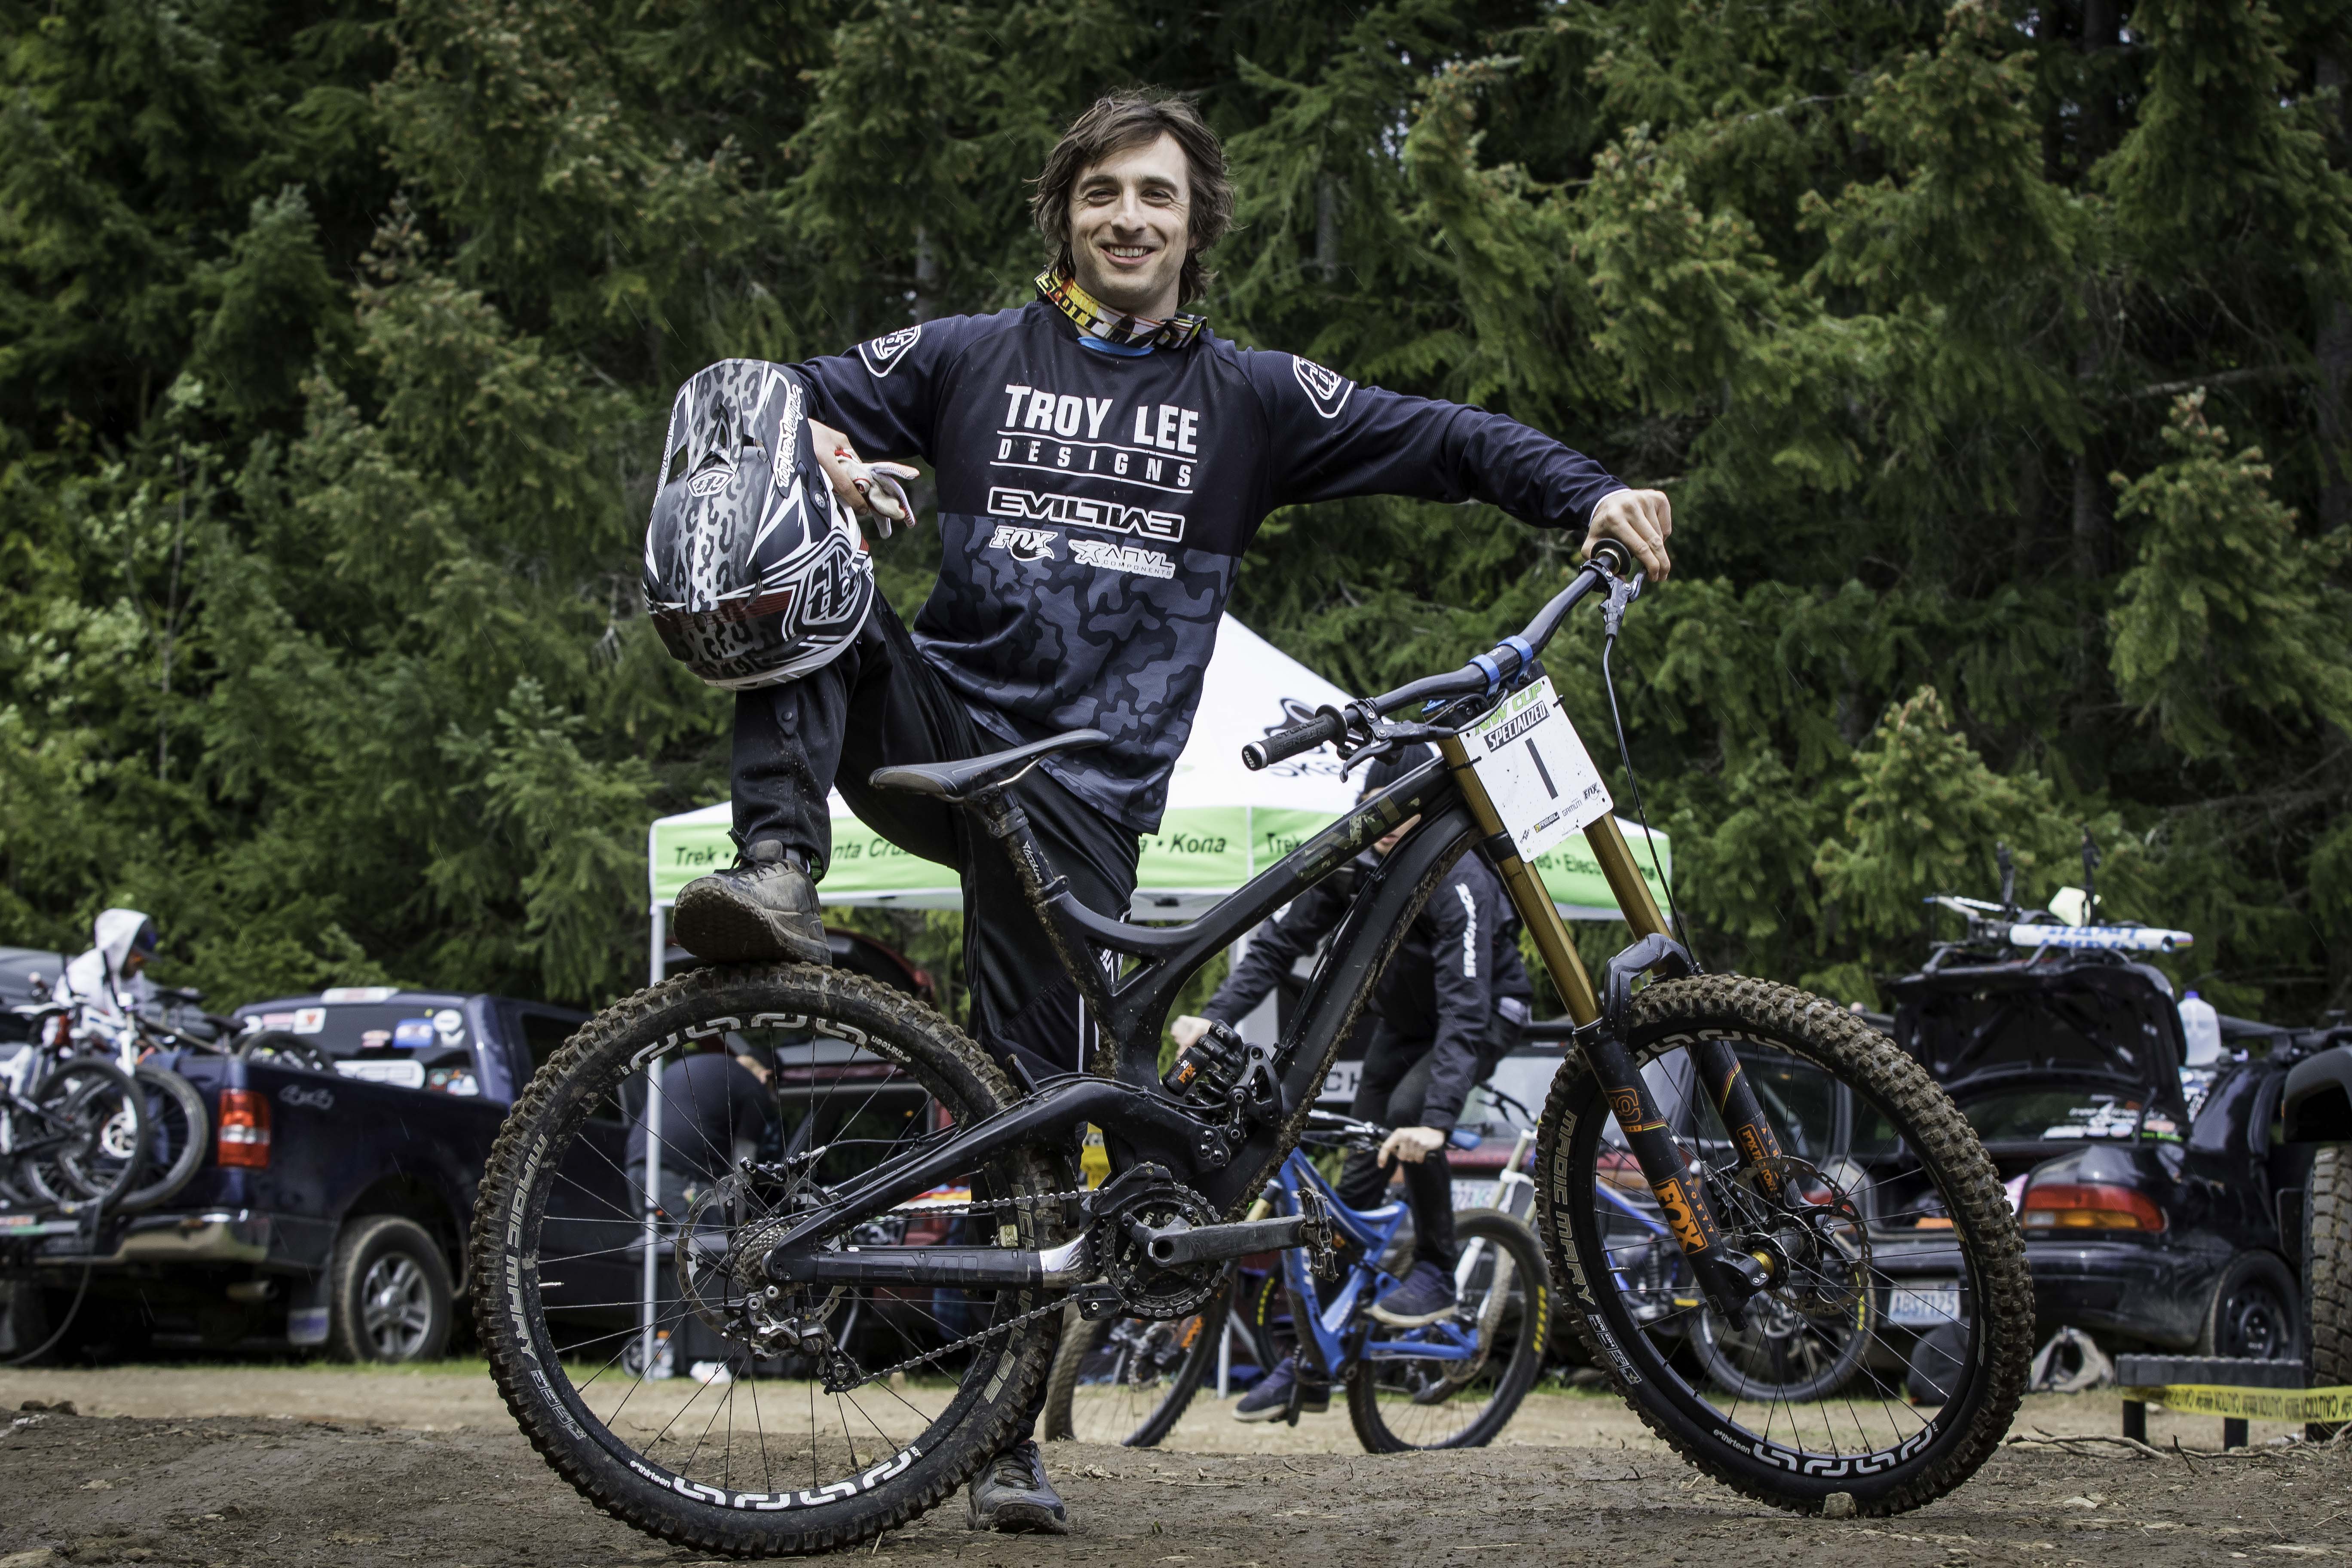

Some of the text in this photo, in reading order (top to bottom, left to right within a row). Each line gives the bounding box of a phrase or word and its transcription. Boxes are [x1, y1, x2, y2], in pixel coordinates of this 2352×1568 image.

[1005, 385, 1199, 453] TROY LEE
[998, 439, 1191, 487] DESIGNS
[989, 525, 1058, 554] FOX
[1103, 560, 1172, 576] COMPONENTS
[1475, 683, 1542, 735] NW CUP
[1488, 701, 1547, 750] SPECIALIZED
[1525, 737, 1559, 800] 1
[1583, 783, 1598, 799] FOX
[674, 846, 716, 866] Trek
[869, 837, 908, 857] Cru
[1169, 833, 1227, 854] Kona
[1554, 1109, 1596, 1307] MAGIC MARY
[1654, 1181, 1704, 1254] FOX
[506, 1132, 548, 1361] MAGIC MARY
